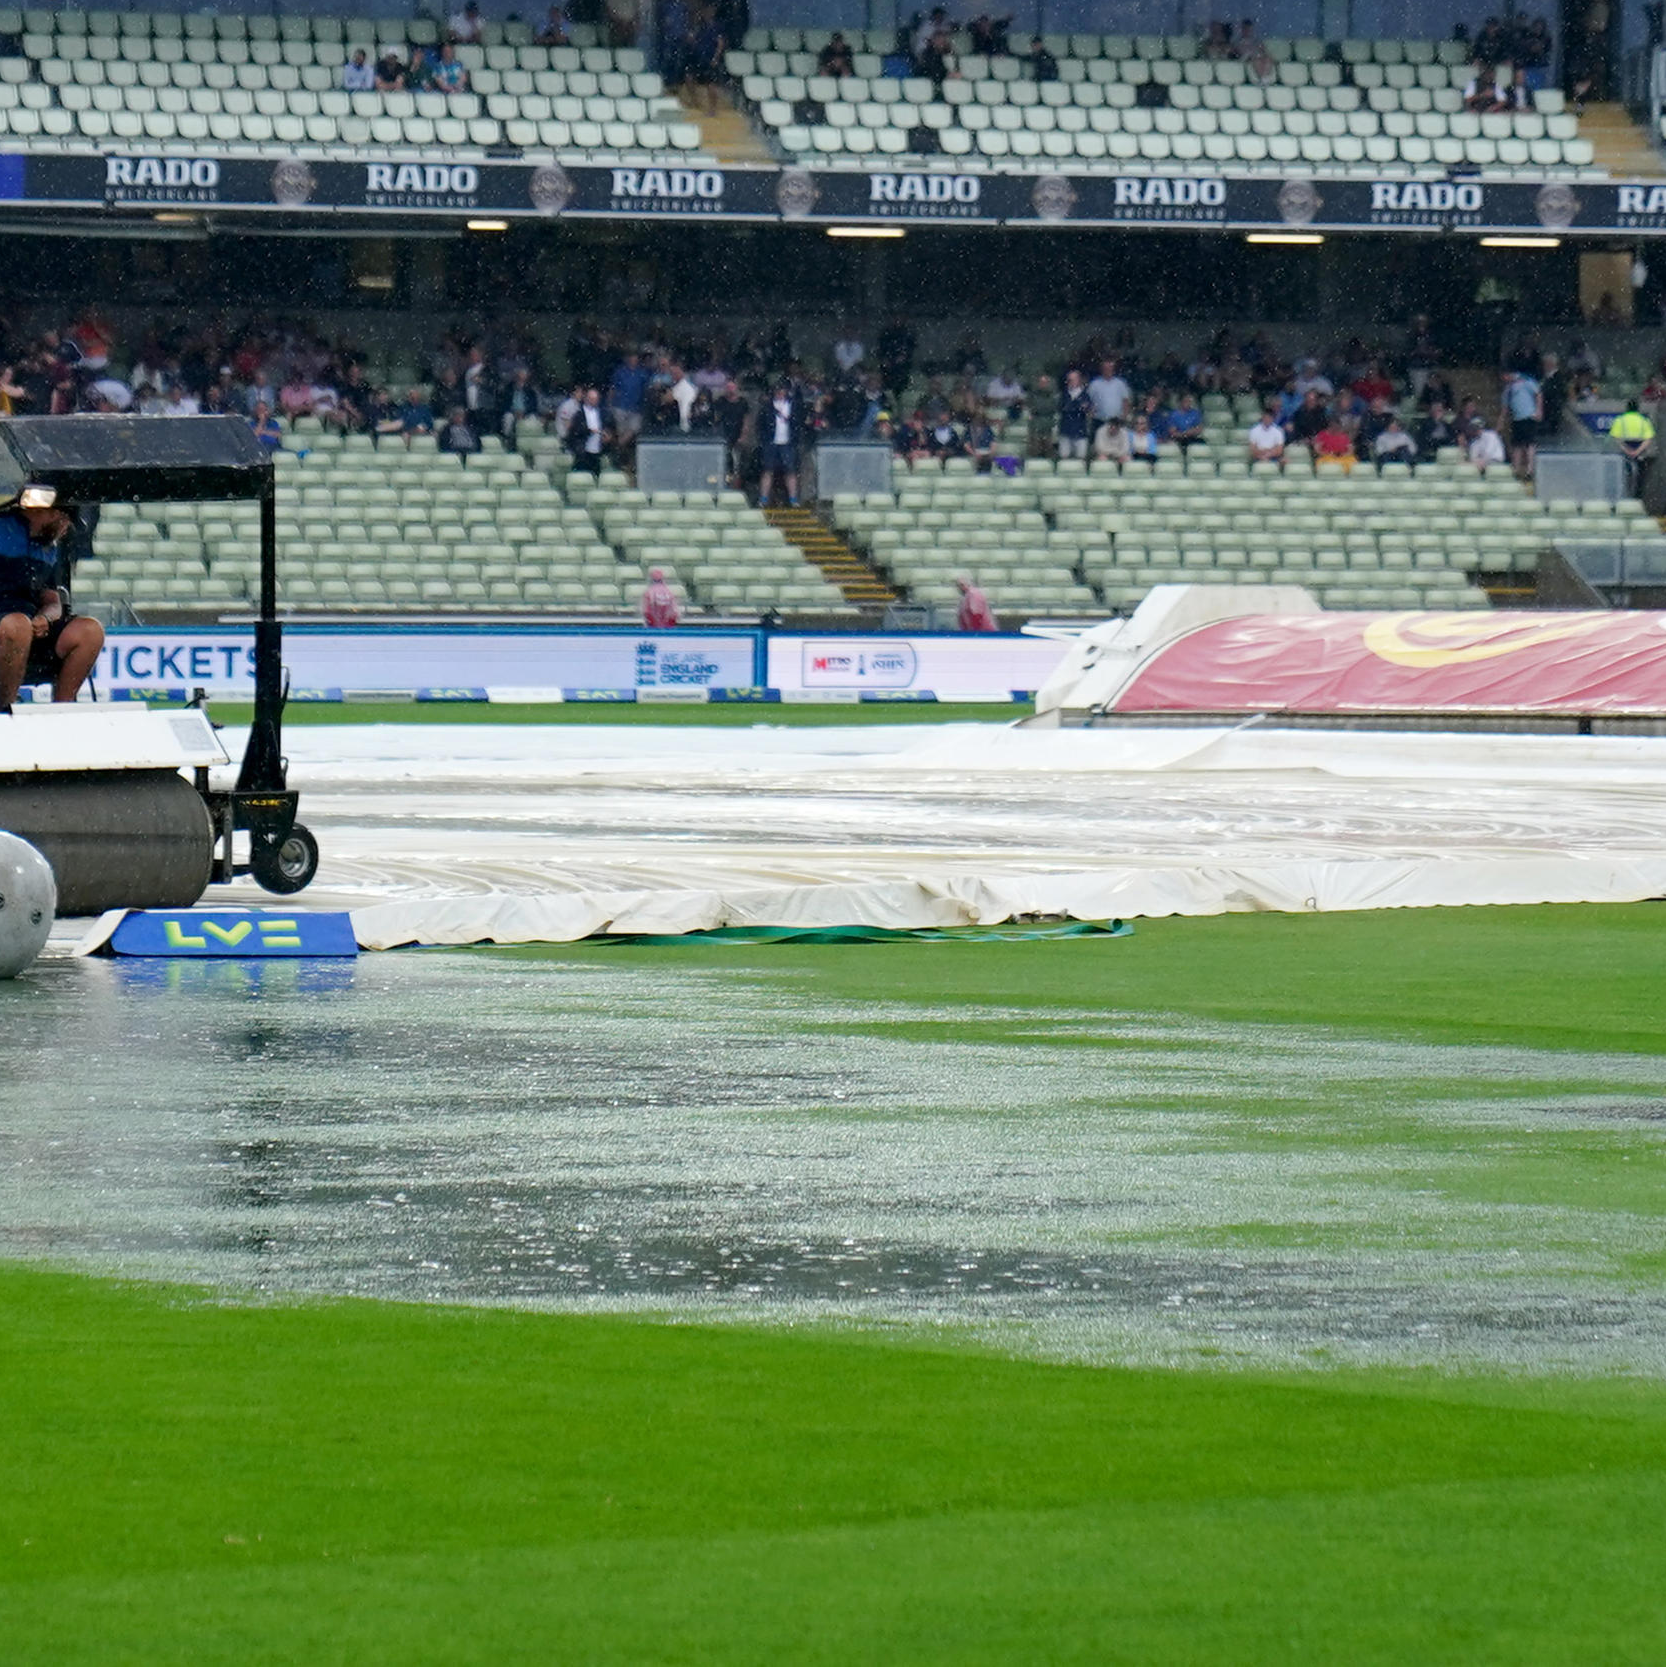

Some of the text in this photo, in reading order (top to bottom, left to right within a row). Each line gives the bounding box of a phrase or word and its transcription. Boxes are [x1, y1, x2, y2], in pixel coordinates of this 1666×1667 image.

[106, 158, 220, 188] RADO
[367, 164, 479, 193] RADO
[611, 169, 725, 198] RADO
[870, 175, 981, 203] RADO
[1114, 178, 1226, 206] RADO
[1371, 183, 1483, 212] RADO
[660, 664, 719, 674] ENGLAND
